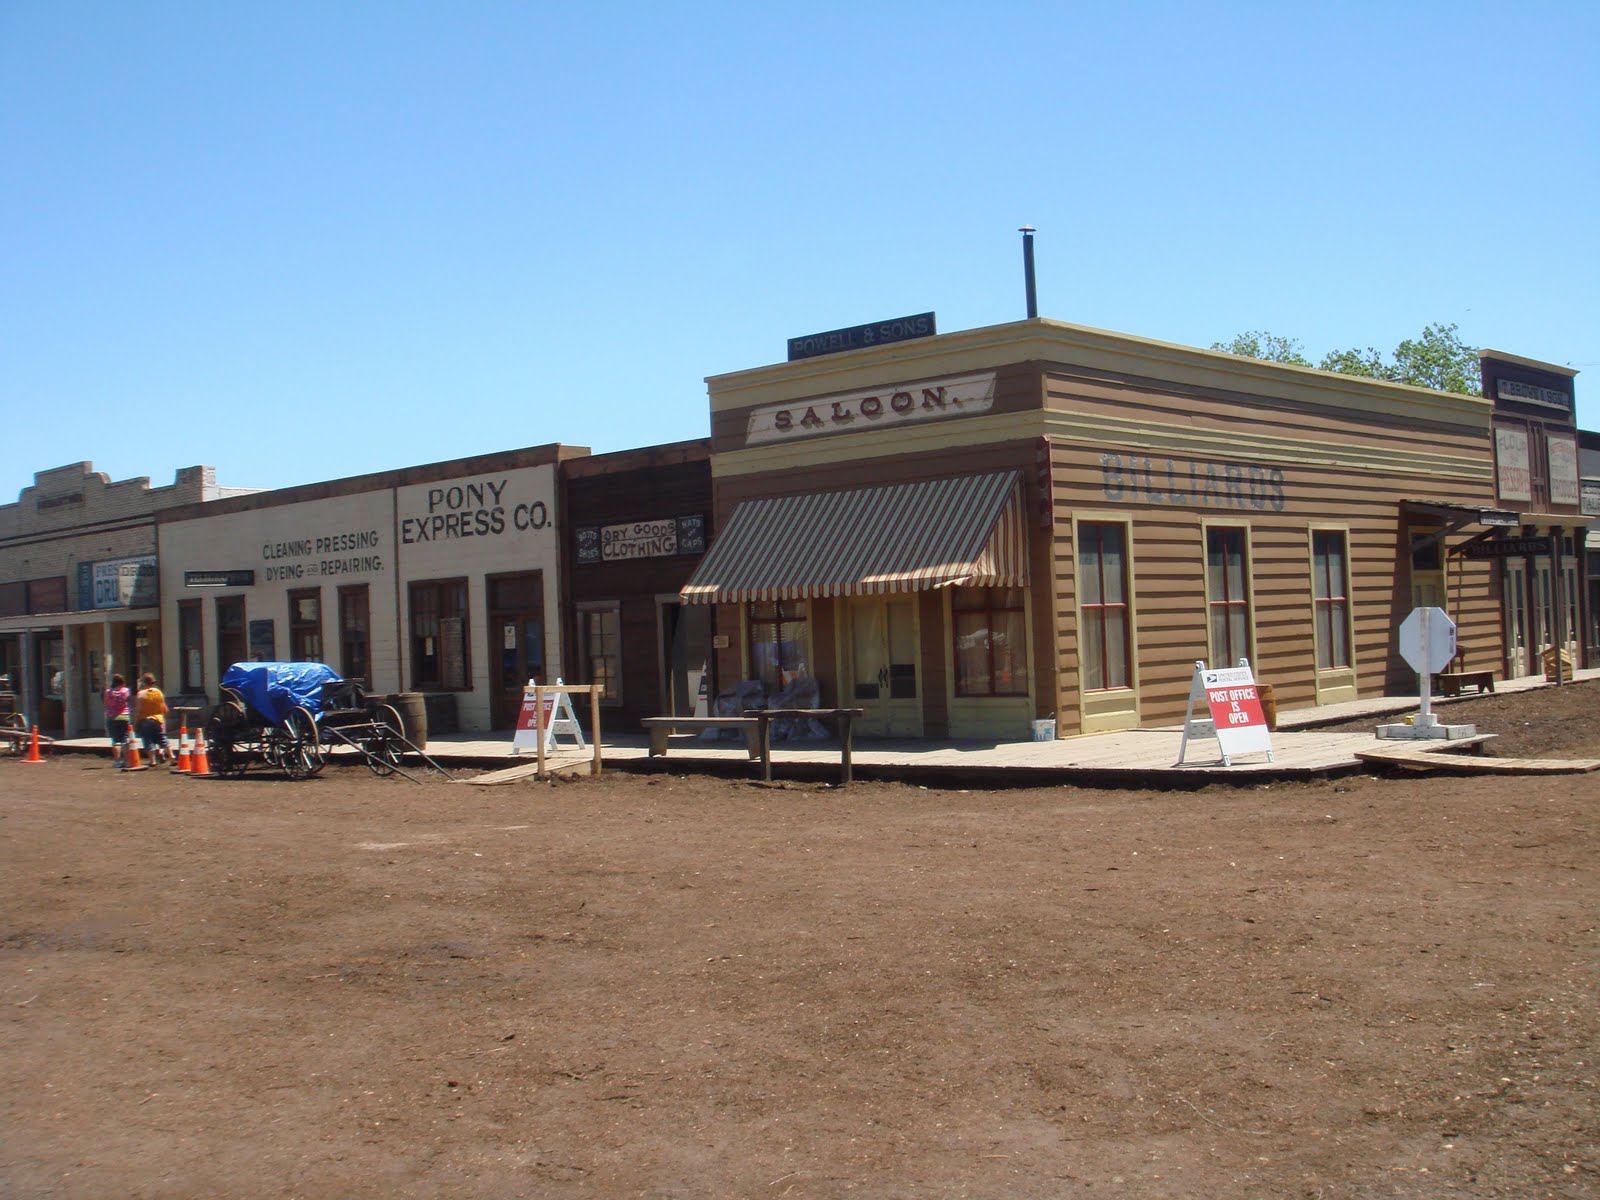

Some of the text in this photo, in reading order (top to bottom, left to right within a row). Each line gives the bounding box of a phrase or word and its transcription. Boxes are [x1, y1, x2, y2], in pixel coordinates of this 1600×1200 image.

[863, 327, 875, 344] &
[879, 317, 929, 340] SONS
[1101, 452, 1285, 512] BILLIARDS
[428, 479, 508, 513] PONY
[402, 501, 552, 544] EXPRESS CO.
[604, 522, 675, 542] DRY GOODS
[263, 530, 379, 560] CLEANING PRESSING
[681, 537, 703, 549] CAPS
[266, 564, 304, 581] DYEING
[1209, 688, 1256, 703] POST OFFICE
[1231, 701, 1240, 712] IS
[1228, 712, 1249, 724] OPEN
